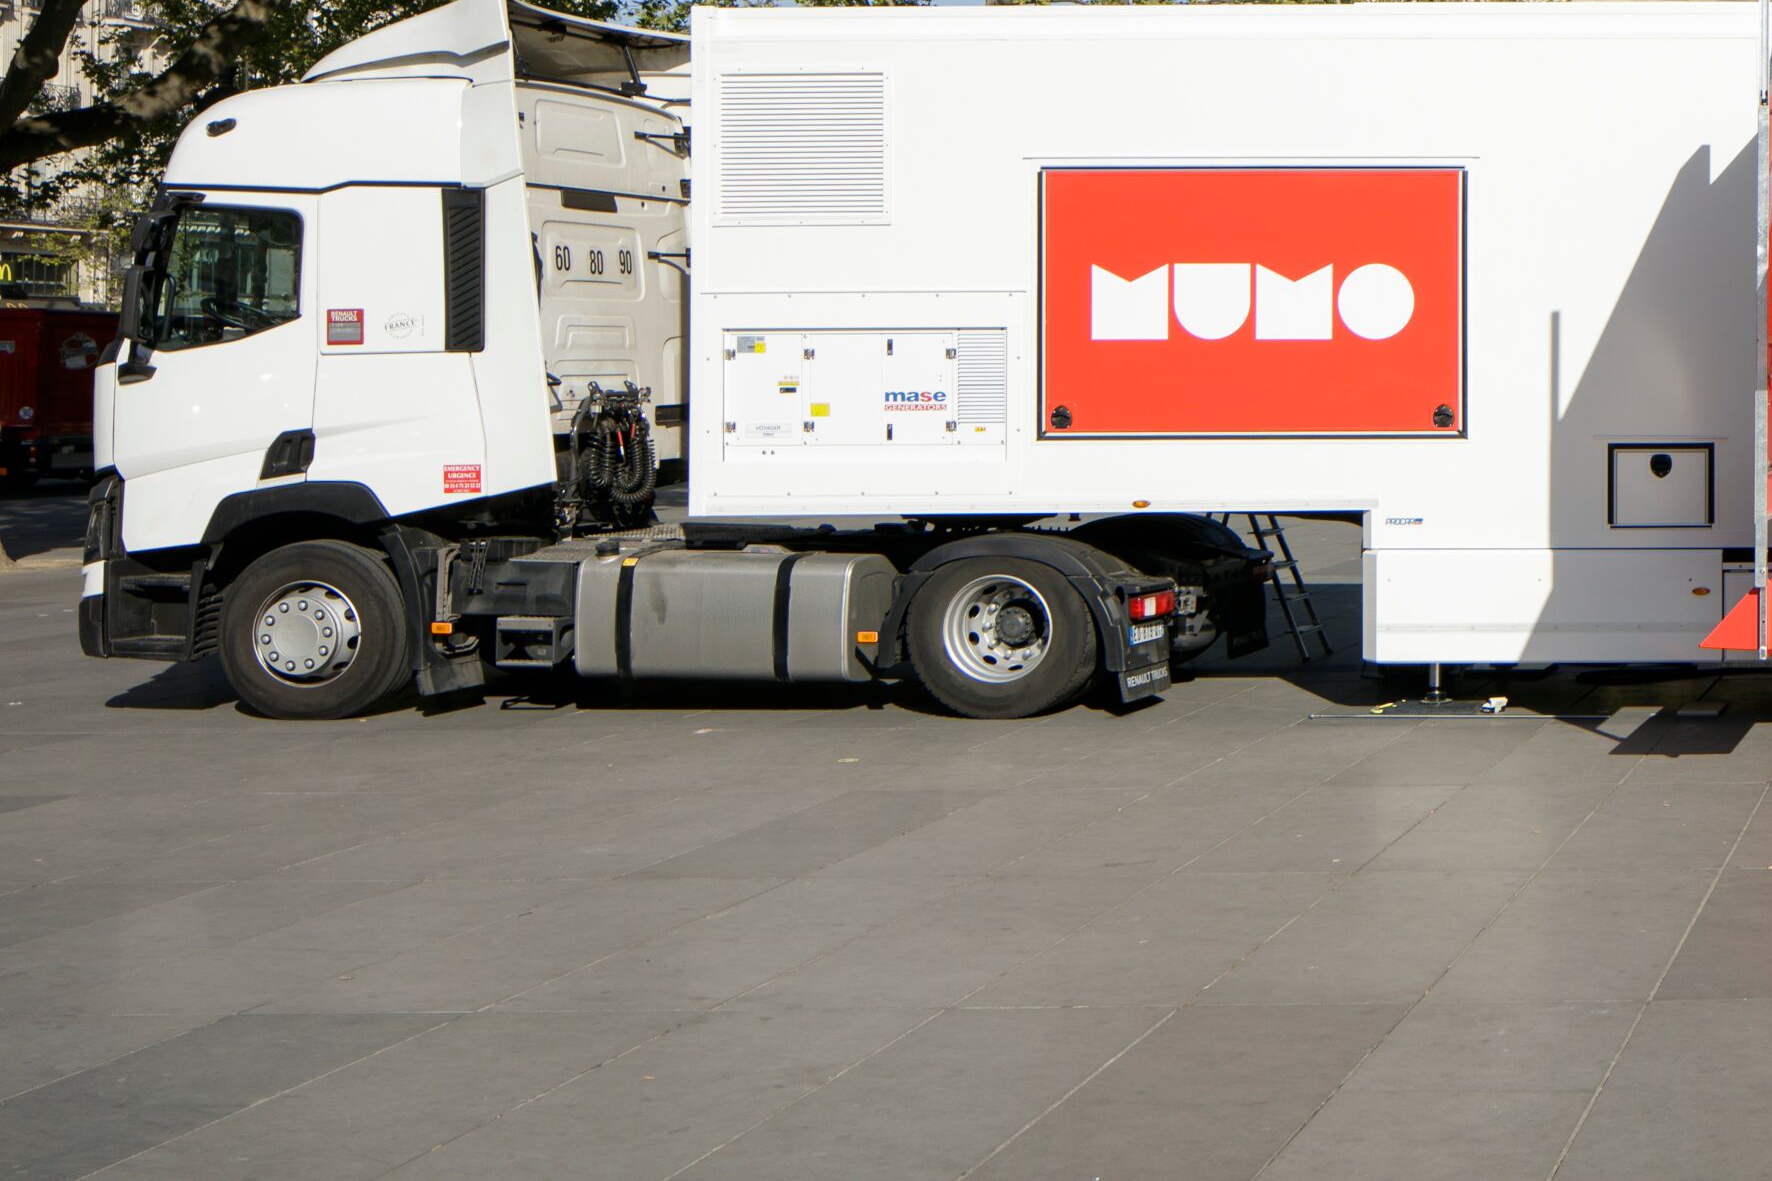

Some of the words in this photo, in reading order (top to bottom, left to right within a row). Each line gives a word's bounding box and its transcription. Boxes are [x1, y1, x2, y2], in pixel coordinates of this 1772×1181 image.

[555, 245, 571, 271] 60
[590, 250, 604, 275] 80
[619, 249, 632, 274] 90
[1092, 264, 1414, 340] MUMO
[384, 319, 416, 331] FRANCE
[885, 391, 946, 402] mase
[1127, 672, 1151, 688] RENAULT
[1151, 667, 1168, 681] TRUCKS
